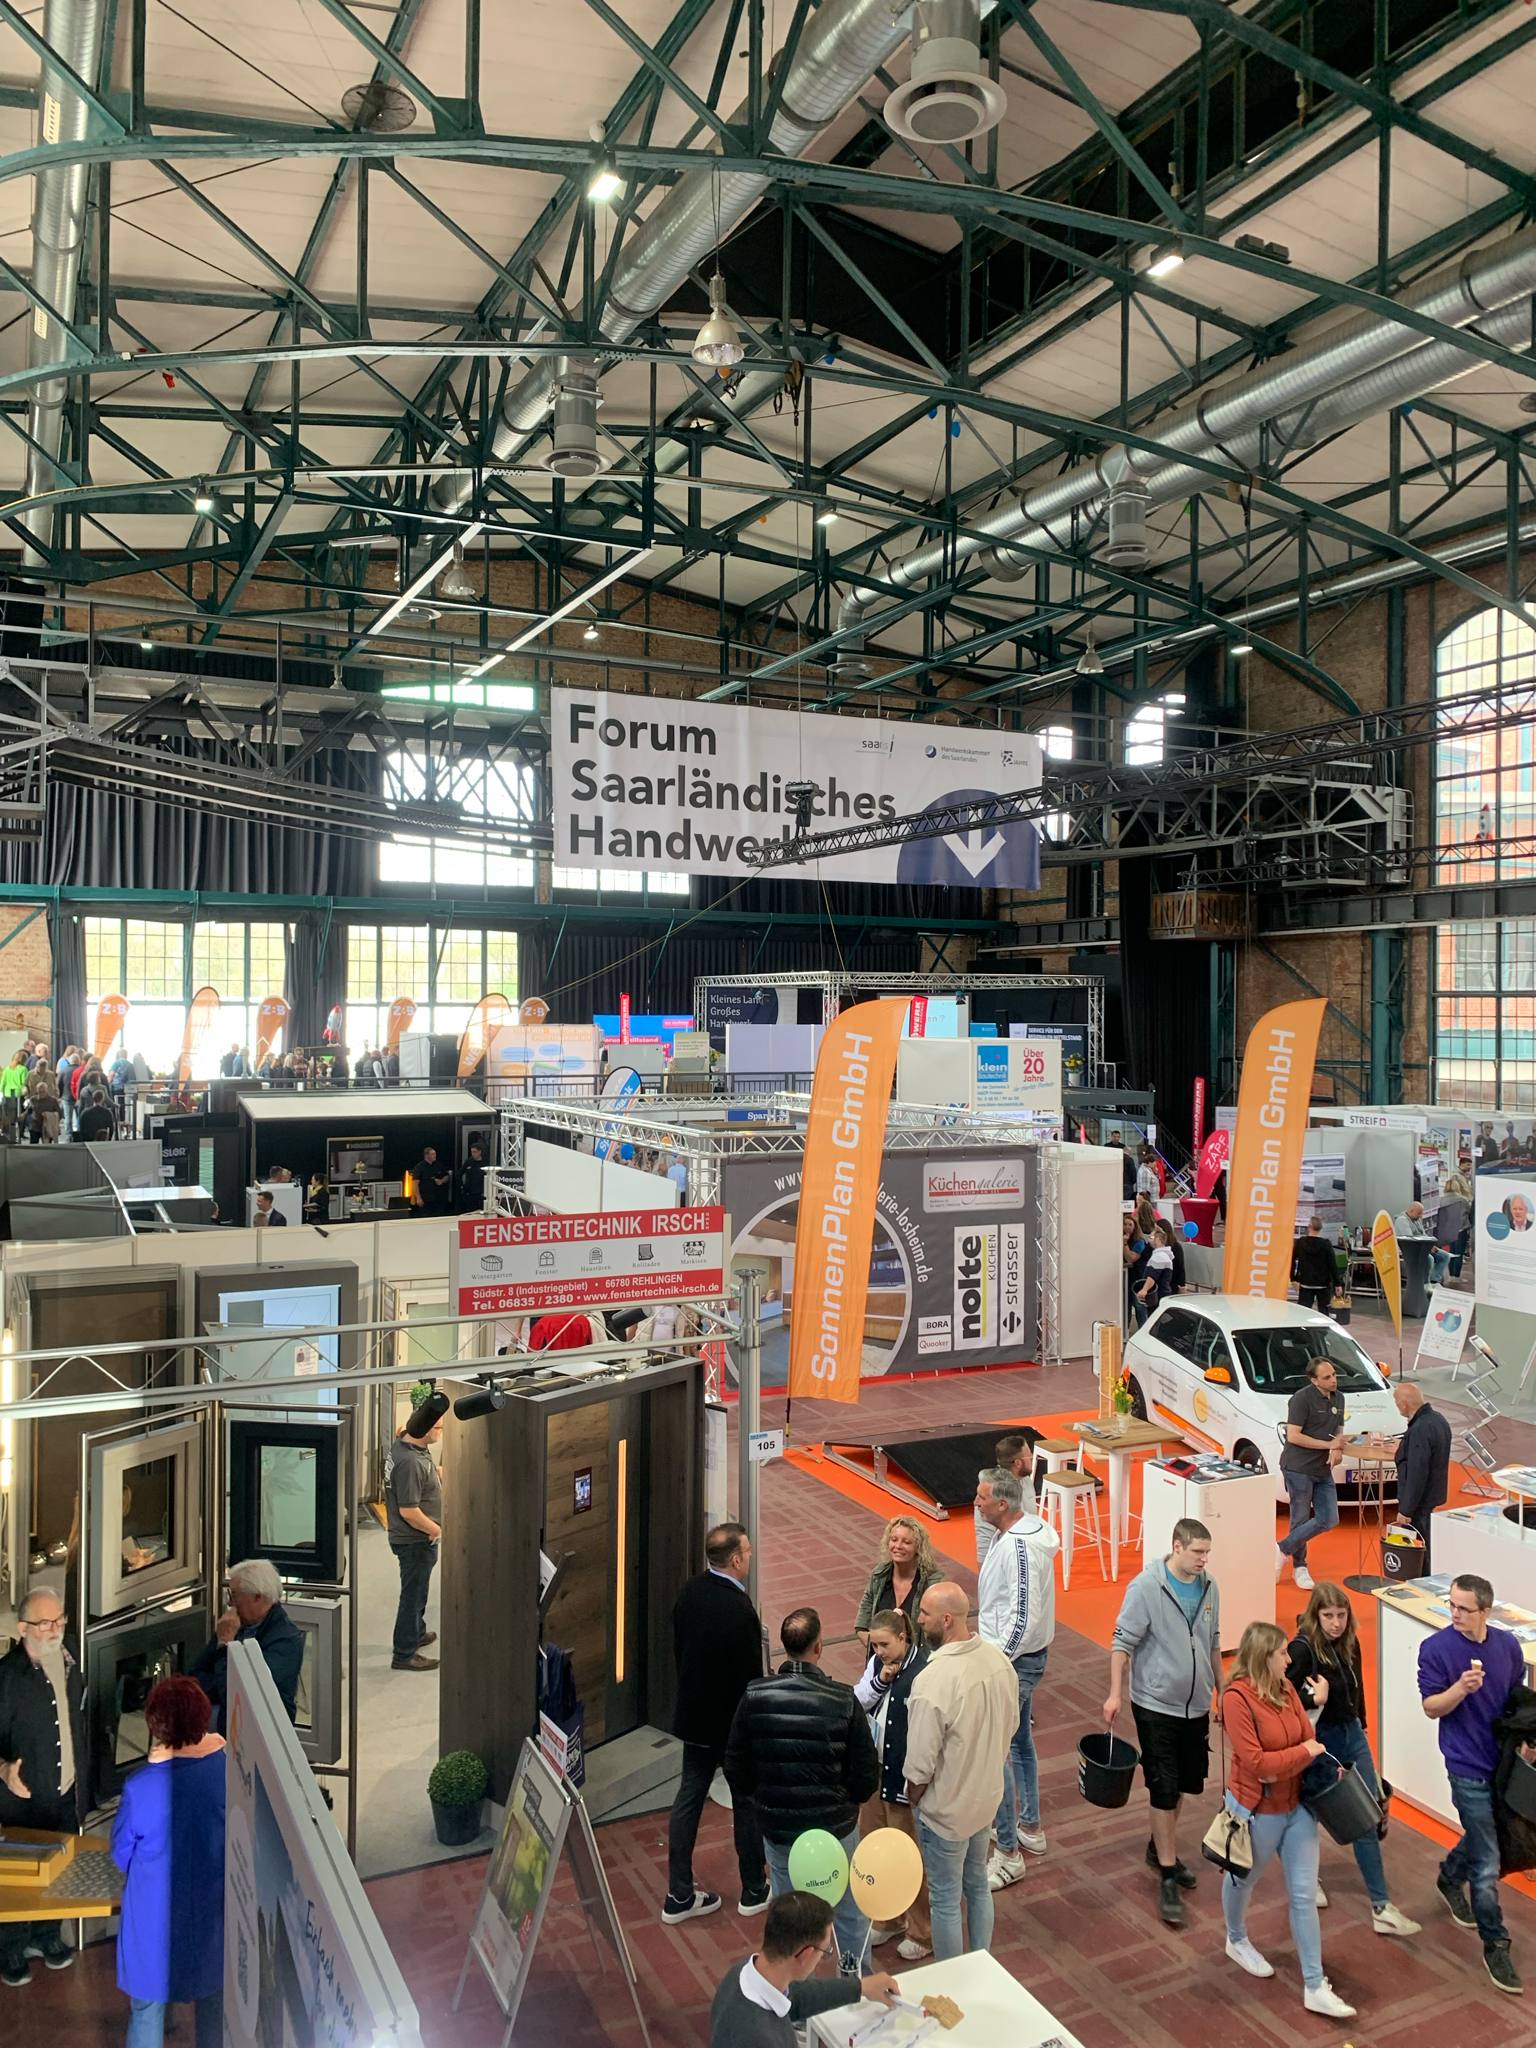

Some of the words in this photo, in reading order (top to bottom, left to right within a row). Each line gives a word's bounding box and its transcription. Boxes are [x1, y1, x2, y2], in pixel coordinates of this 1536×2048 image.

[570, 703, 717, 756] Forum
[570, 758, 897, 821] Saarländisches
[710, 994, 742, 1004] Kleines
[743, 995, 764, 1005] Lan
[710, 1006, 741, 1018] Großes
[978, 1054, 1008, 1072] klein
[1023, 1047, 1044, 1058] Über
[1023, 1058, 1044, 1075] 20
[1023, 1074, 1044, 1083] Jahre
[1260, 1028, 1296, 1129] GmbH
[832, 1031, 873, 1149] GmbH
[1350, 1115, 1378, 1126] STREIF
[1204, 1134, 1226, 1170] ZAPF
[928, 1171, 977, 1192] Küchen
[473, 1215, 643, 1245] FENSTERTECHNIK
[652, 1212, 705, 1234] IRSCH
[535, 1268, 559, 1276] Fenster
[811, 1160, 856, 1382] SonnenPlan
[1005, 1232, 1018, 1305] strasser
[472, 1301, 495, 1311] Tel.
[498, 1297, 535, 1309] 06835
[545, 1294, 574, 1305] 2380
[583, 1283, 720, 1302] www.fenstertechnik-irsch.de
[473, 1289, 506, 1299] Südstr.
[508, 1287, 514, 1296] 8
[516, 1281, 589, 1297] (Industriegebiet)
[605, 1279, 630, 1289] 66780
[632, 1274, 683, 1286] REHLINGEN
[958, 1235, 982, 1339] nolte
[926, 1320, 949, 1329] BORA
[919, 1340, 949, 1350] Quooker
[757, 1440, 776, 1451] 105
